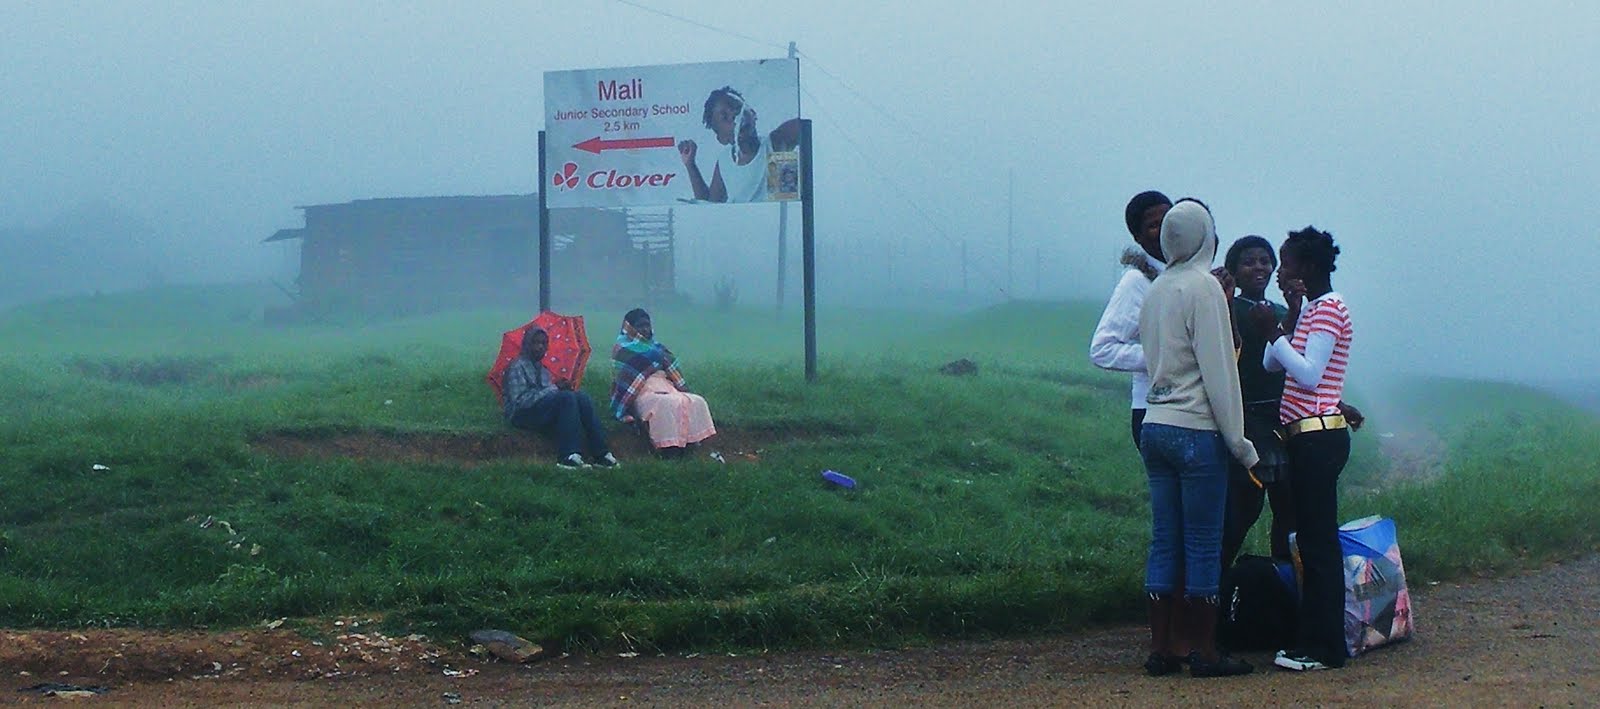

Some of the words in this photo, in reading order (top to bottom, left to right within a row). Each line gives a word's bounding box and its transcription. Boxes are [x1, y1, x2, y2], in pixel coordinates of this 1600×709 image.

[598, 78, 643, 101] Mali
[554, 110, 588, 120] Junior
[591, 106, 649, 119] Secondary
[652, 103, 690, 116] School
[604, 121, 621, 132] 2.5
[623, 120, 640, 131] km
[586, 169, 676, 189] Clover
